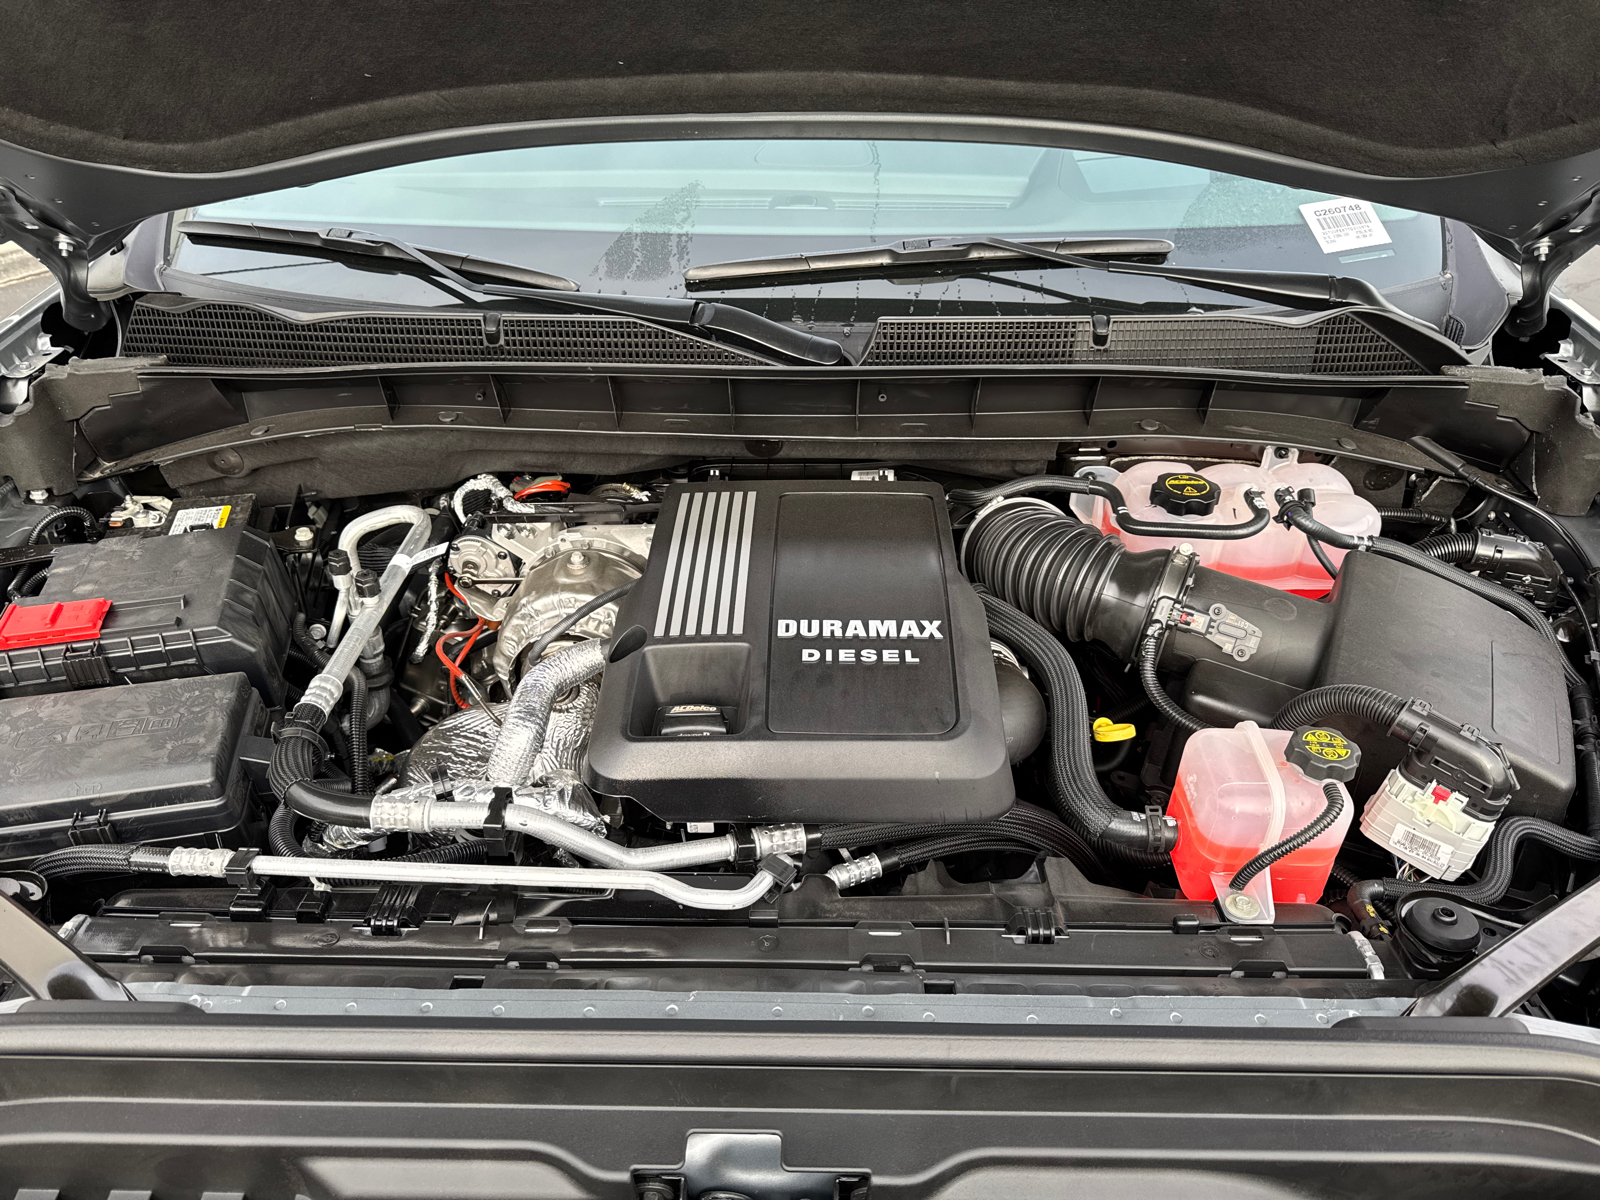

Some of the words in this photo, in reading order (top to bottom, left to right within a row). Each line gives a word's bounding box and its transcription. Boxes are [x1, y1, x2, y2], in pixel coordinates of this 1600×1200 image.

[1314, 204, 1361, 216] C260748
[777, 619, 943, 639] DURAMAX
[802, 648, 920, 664] DIESEL
[669, 705, 717, 714] ACDelco
